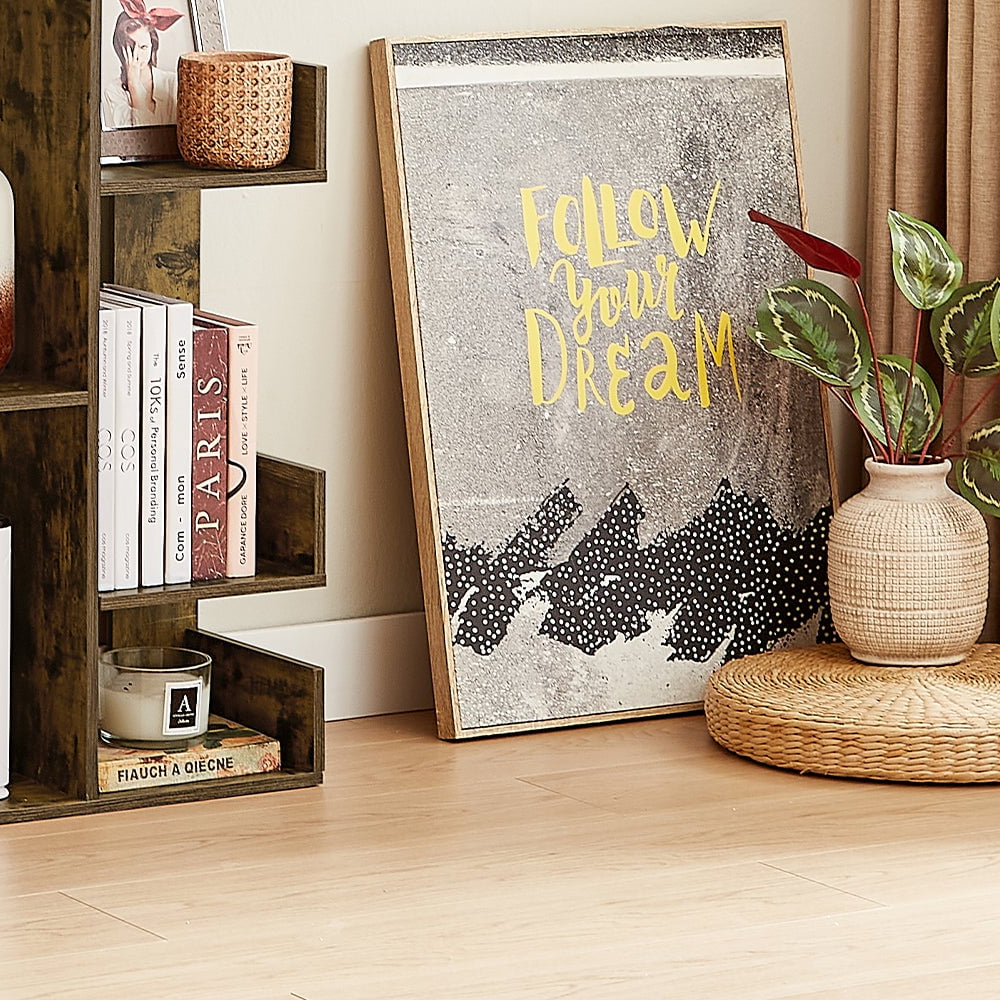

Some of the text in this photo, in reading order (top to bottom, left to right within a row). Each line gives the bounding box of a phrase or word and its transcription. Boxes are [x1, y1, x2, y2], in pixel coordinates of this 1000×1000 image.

[520, 174, 721, 268] FOLLOW
[550, 254, 684, 345] your
[176, 339, 186, 379] Sense
[149, 377, 162, 415] 10Ks
[120, 428, 136, 474] COS
[150, 426, 160, 473] Personal
[195, 377, 223, 532] PARIS
[147, 475, 159, 524] Branding
[177, 475, 185, 505] mon
[175, 530, 185, 562] Com
[239, 494, 248, 565] GARANCE DORE
[177, 694, 192, 713] A
[117, 756, 234, 783] FIAUCH A QIECNE
